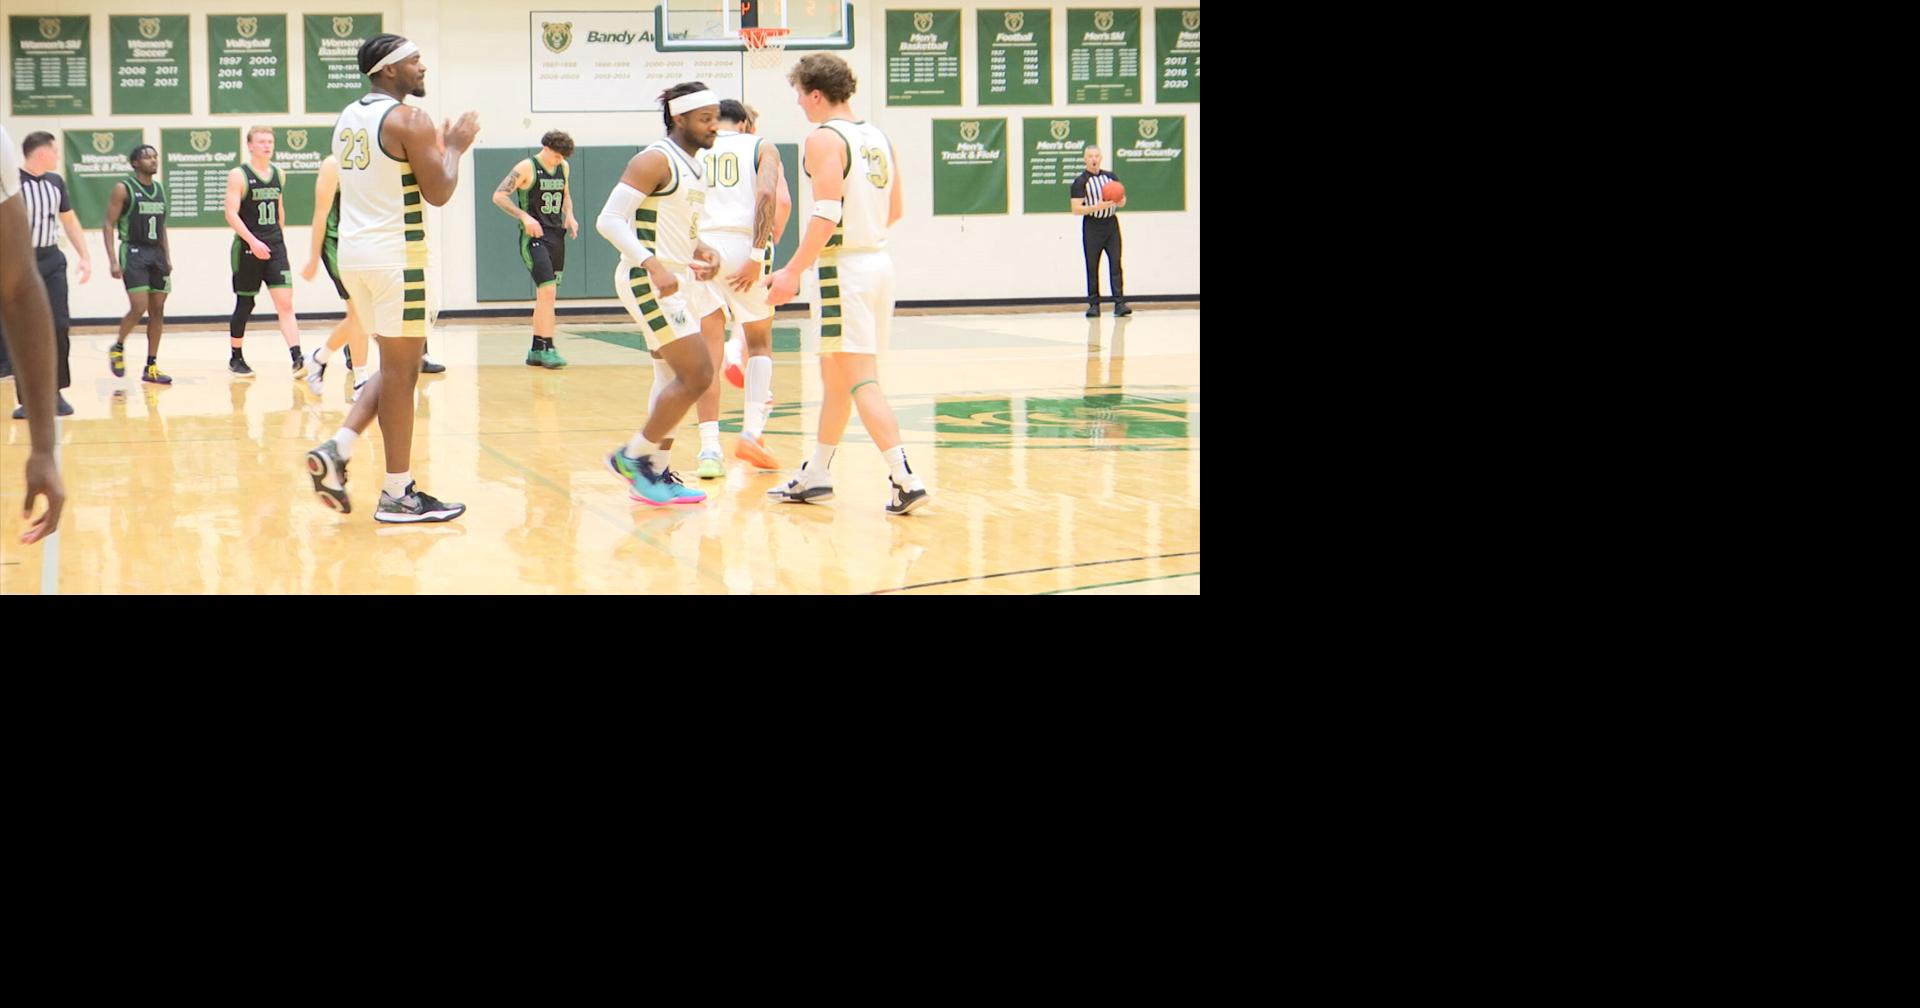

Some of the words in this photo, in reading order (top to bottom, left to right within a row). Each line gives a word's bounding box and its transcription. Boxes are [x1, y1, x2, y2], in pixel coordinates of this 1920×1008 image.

[587, 30, 635, 45] Bandy
[910, 33, 938, 43] Men's
[995, 33, 1034, 43] Football
[1083, 32, 1110, 41] Men's
[1110, 32, 1126, 41] Ski
[20, 40, 65, 49] Women's
[65, 40, 82, 49] Ski
[127, 40, 174, 49] Women's
[225, 38, 272, 49] Volleyball
[899, 41, 949, 51] Basketball
[132, 48, 169, 58] Soccer
[219, 57, 242, 65] 1997
[249, 56, 278, 65] 2000
[155, 66, 178, 75] 2011
[217, 69, 243, 77] 2014
[251, 68, 277, 77] 2015
[120, 78, 145, 87] 2012
[217, 80, 243, 89] 2018
[1162, 80, 1189, 89] 2020
[340, 128, 370, 170] 23
[957, 142, 985, 151] Men's
[1036, 141, 1063, 150] Men's
[1064, 140, 1085, 150] Golf
[1134, 141, 1162, 150] Men's
[168, 152, 213, 162] Women's
[214, 152, 237, 162] Golf
[275, 151, 321, 161] Women's
[941, 151, 967, 160] Track
[976, 149, 1001, 160] Field
[1117, 149, 1143, 158] Cross
[1143, 148, 1182, 158] Country
[81, 154, 129, 164] Women's
[703, 152, 739, 187] 10
[541, 192, 562, 214] 33
[257, 202, 277, 225] 11
[148, 216, 158, 239] 1
